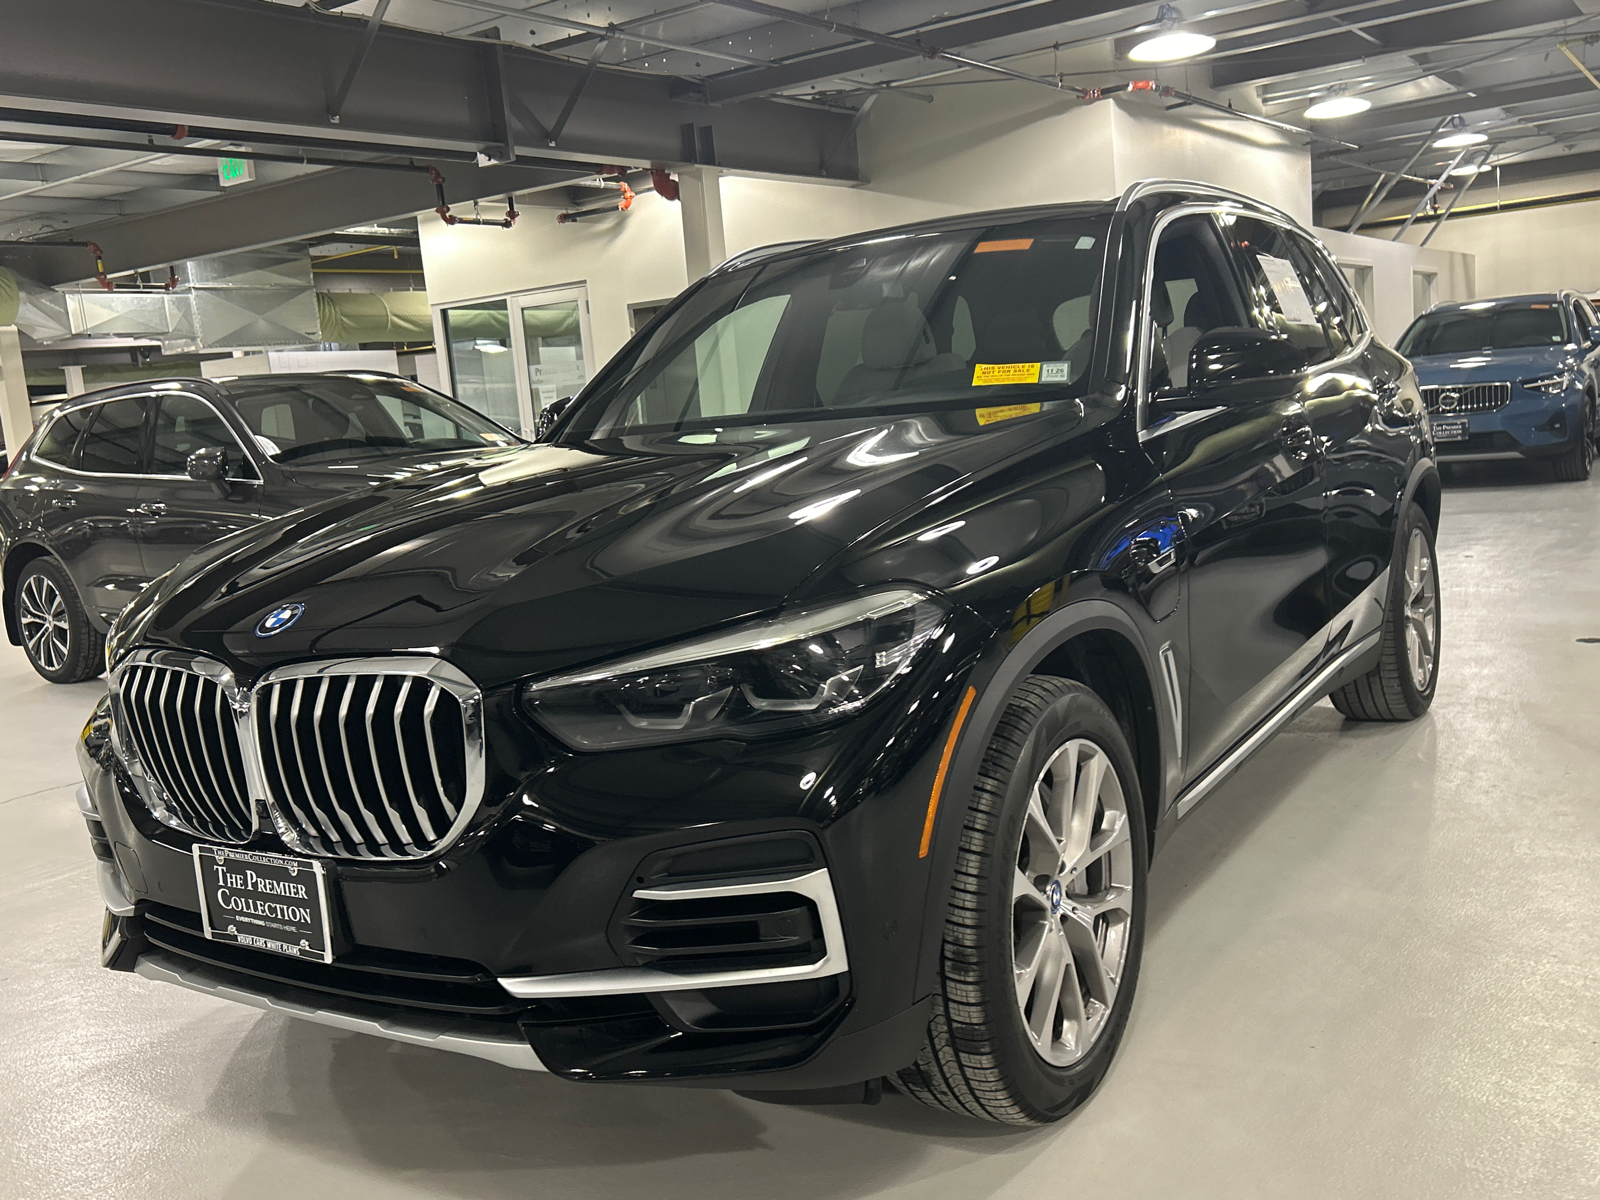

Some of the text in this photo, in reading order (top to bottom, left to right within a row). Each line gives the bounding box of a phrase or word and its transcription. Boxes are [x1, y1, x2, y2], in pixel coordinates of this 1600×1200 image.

[213, 865, 308, 900] THE PREMIER
[217, 888, 312, 924] COLLECTION
[235, 915, 266, 927] EVERYTHING
[265, 921, 284, 930] STARTS
[237, 934, 300, 956] VOLVO CARS WHITE PLAINS
